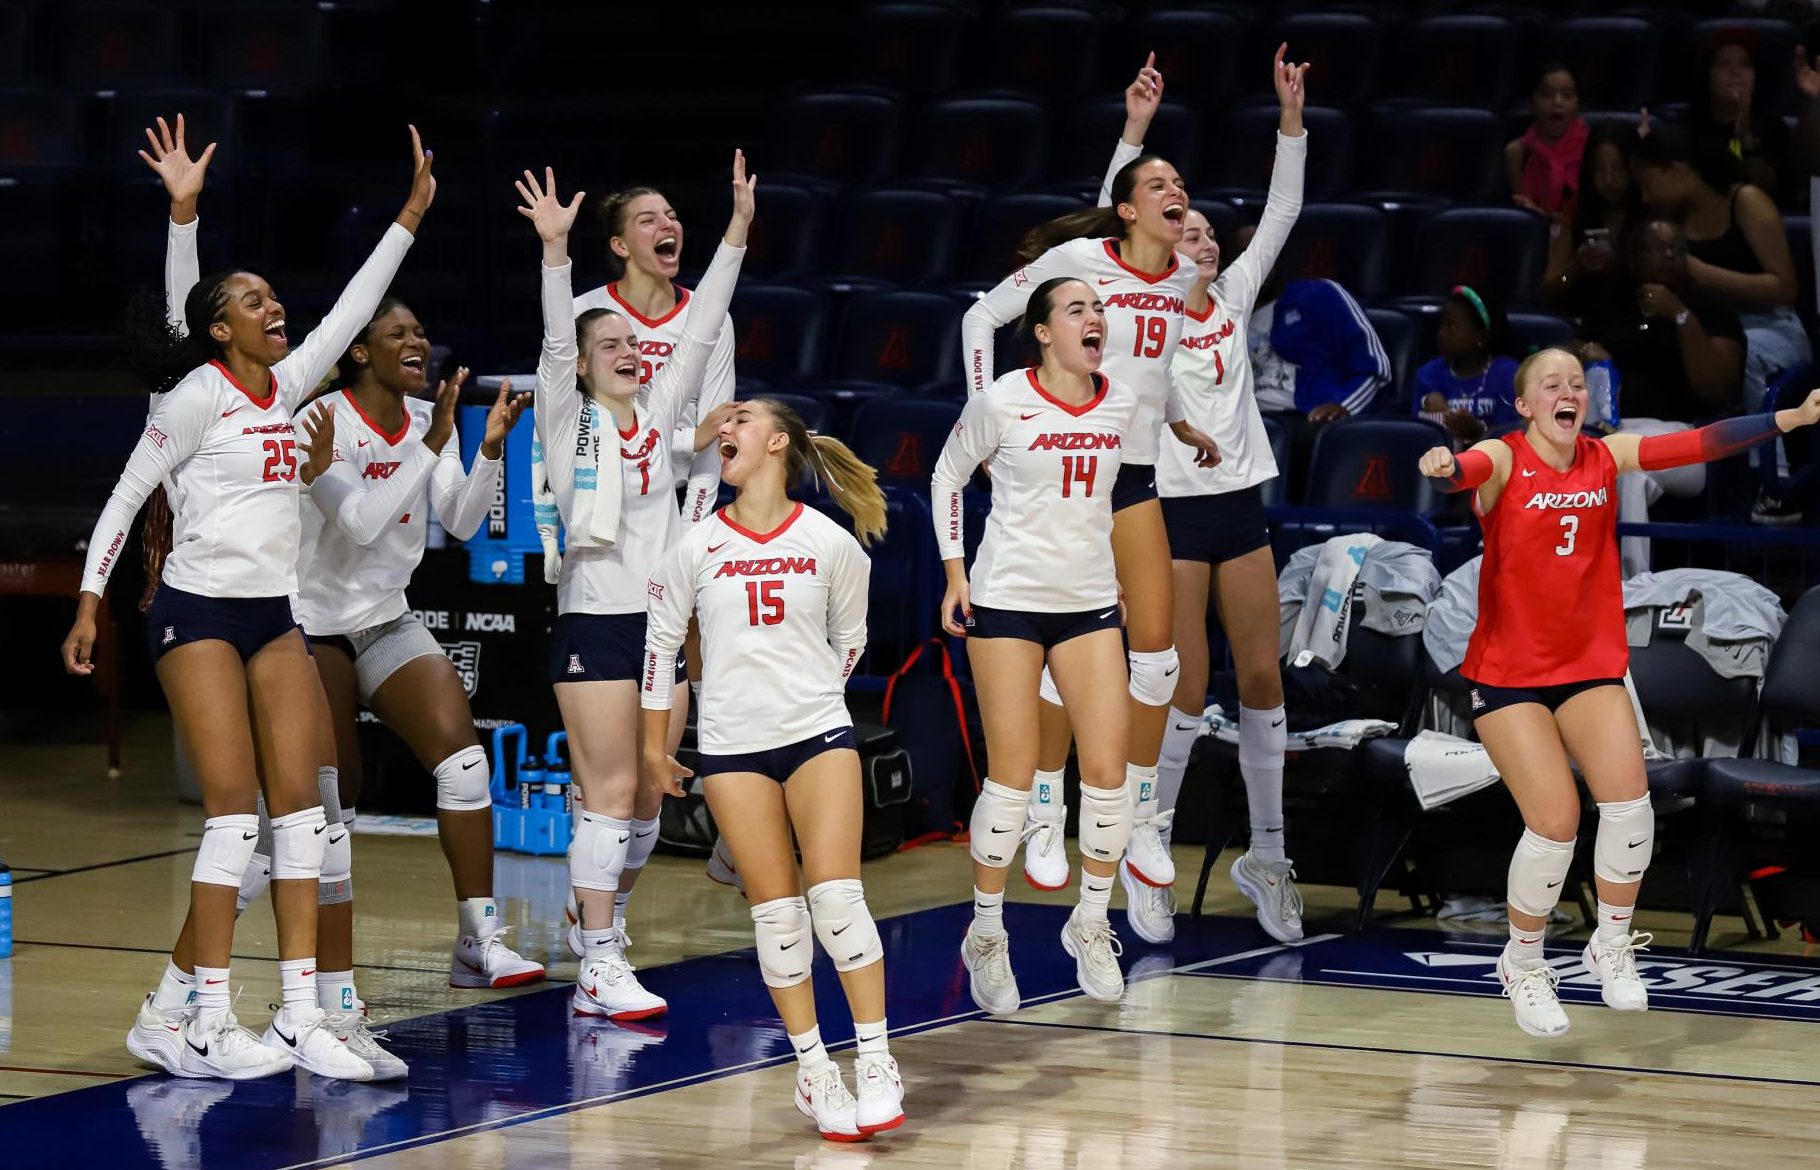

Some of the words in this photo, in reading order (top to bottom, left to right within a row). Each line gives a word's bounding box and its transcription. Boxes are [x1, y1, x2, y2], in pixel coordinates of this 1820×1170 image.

[1133, 315, 1167, 358] 19
[1213, 350, 1224, 385] 1
[1028, 432, 1122, 450] ARIZONA
[263, 440, 297, 482] 25
[362, 461, 402, 480] ARIZ
[1062, 456, 1098, 498] 14
[950, 491, 959, 518] DOWN
[1524, 487, 1608, 511] ARIZONA
[107, 530, 125, 557] DOWN
[950, 520, 959, 541] BEAR
[1555, 515, 1579, 556] 3
[714, 557, 817, 579] ARIZONA
[745, 580, 785, 627] 15
[465, 613, 516, 633] NCAA
